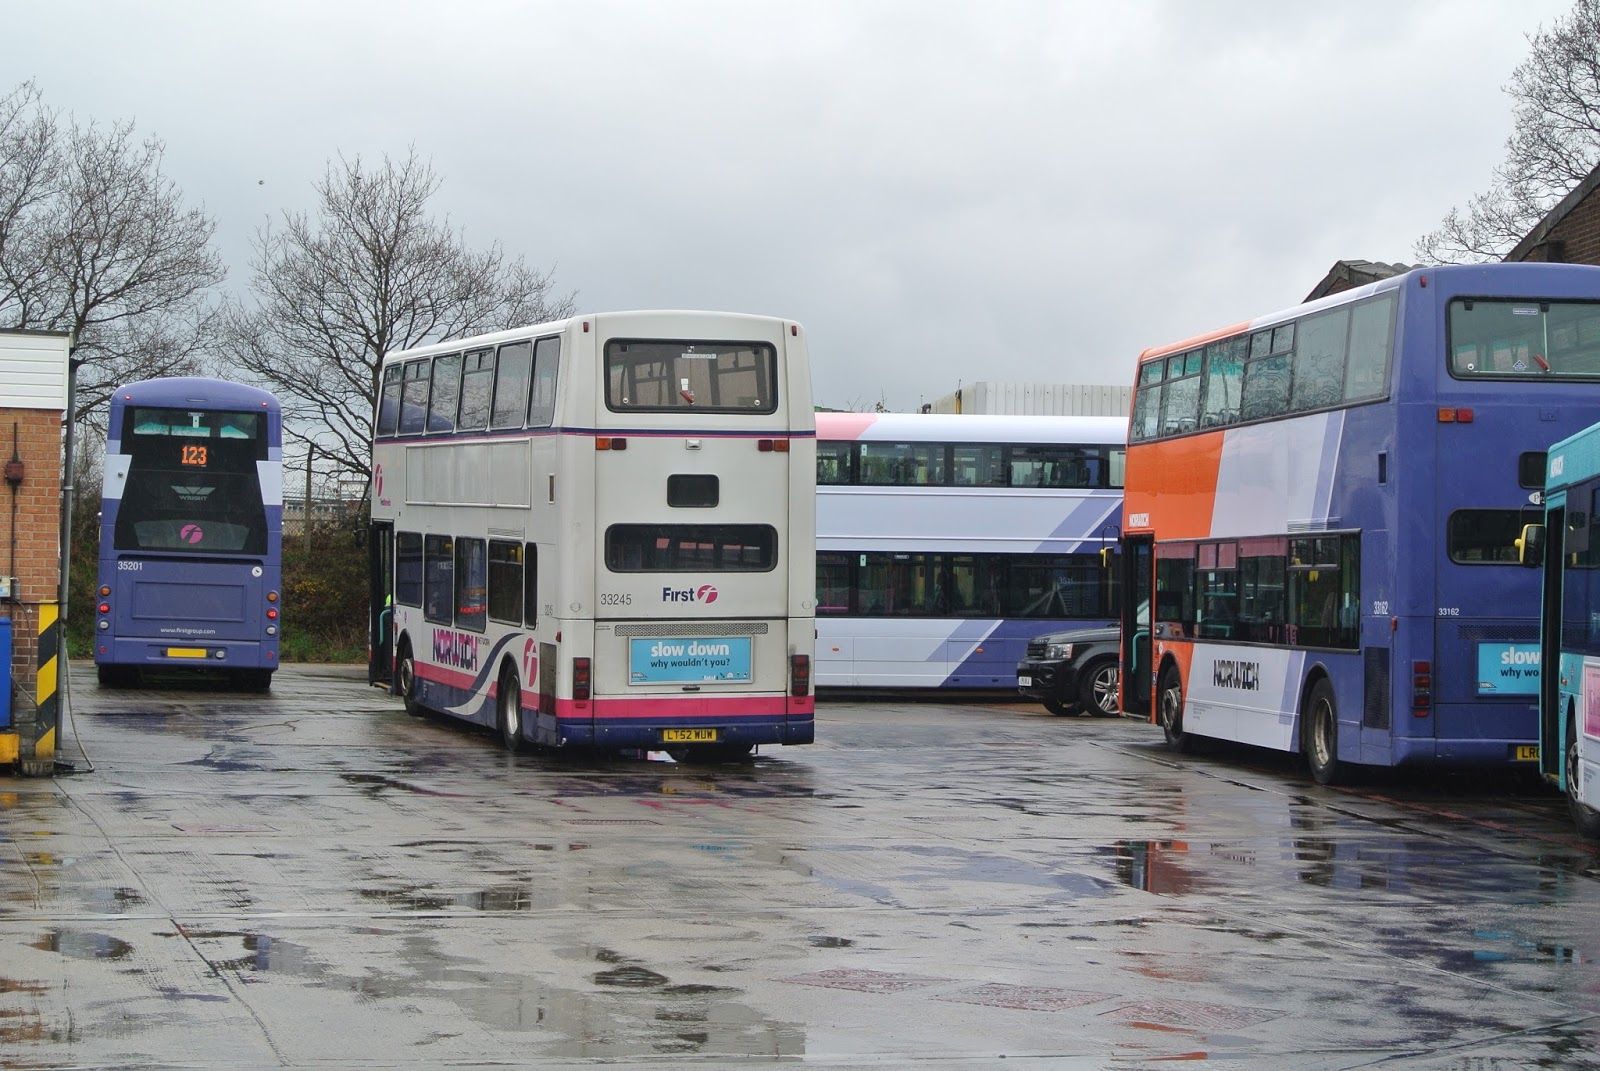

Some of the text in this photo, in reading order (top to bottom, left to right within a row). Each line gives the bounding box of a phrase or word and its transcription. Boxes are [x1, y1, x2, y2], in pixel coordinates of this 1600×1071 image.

[181, 446, 207, 465] 123
[117, 561, 143, 571] 35201
[600, 593, 632, 606] 33245
[662, 587, 695, 602] First
[1374, 601, 1388, 615] 33162
[1438, 607, 1460, 616] 33162
[160, 627, 216, 635] www.firstgroup.com
[432, 628, 478, 671] NORWICH
[651, 640, 730, 657] slow down
[1501, 646, 1540, 665] slow
[650, 657, 731, 669] why wouldn't you?
[1213, 659, 1259, 691] NORWICH
[1500, 667, 1521, 679] why
[667, 730, 713, 740] LT52 WUW
